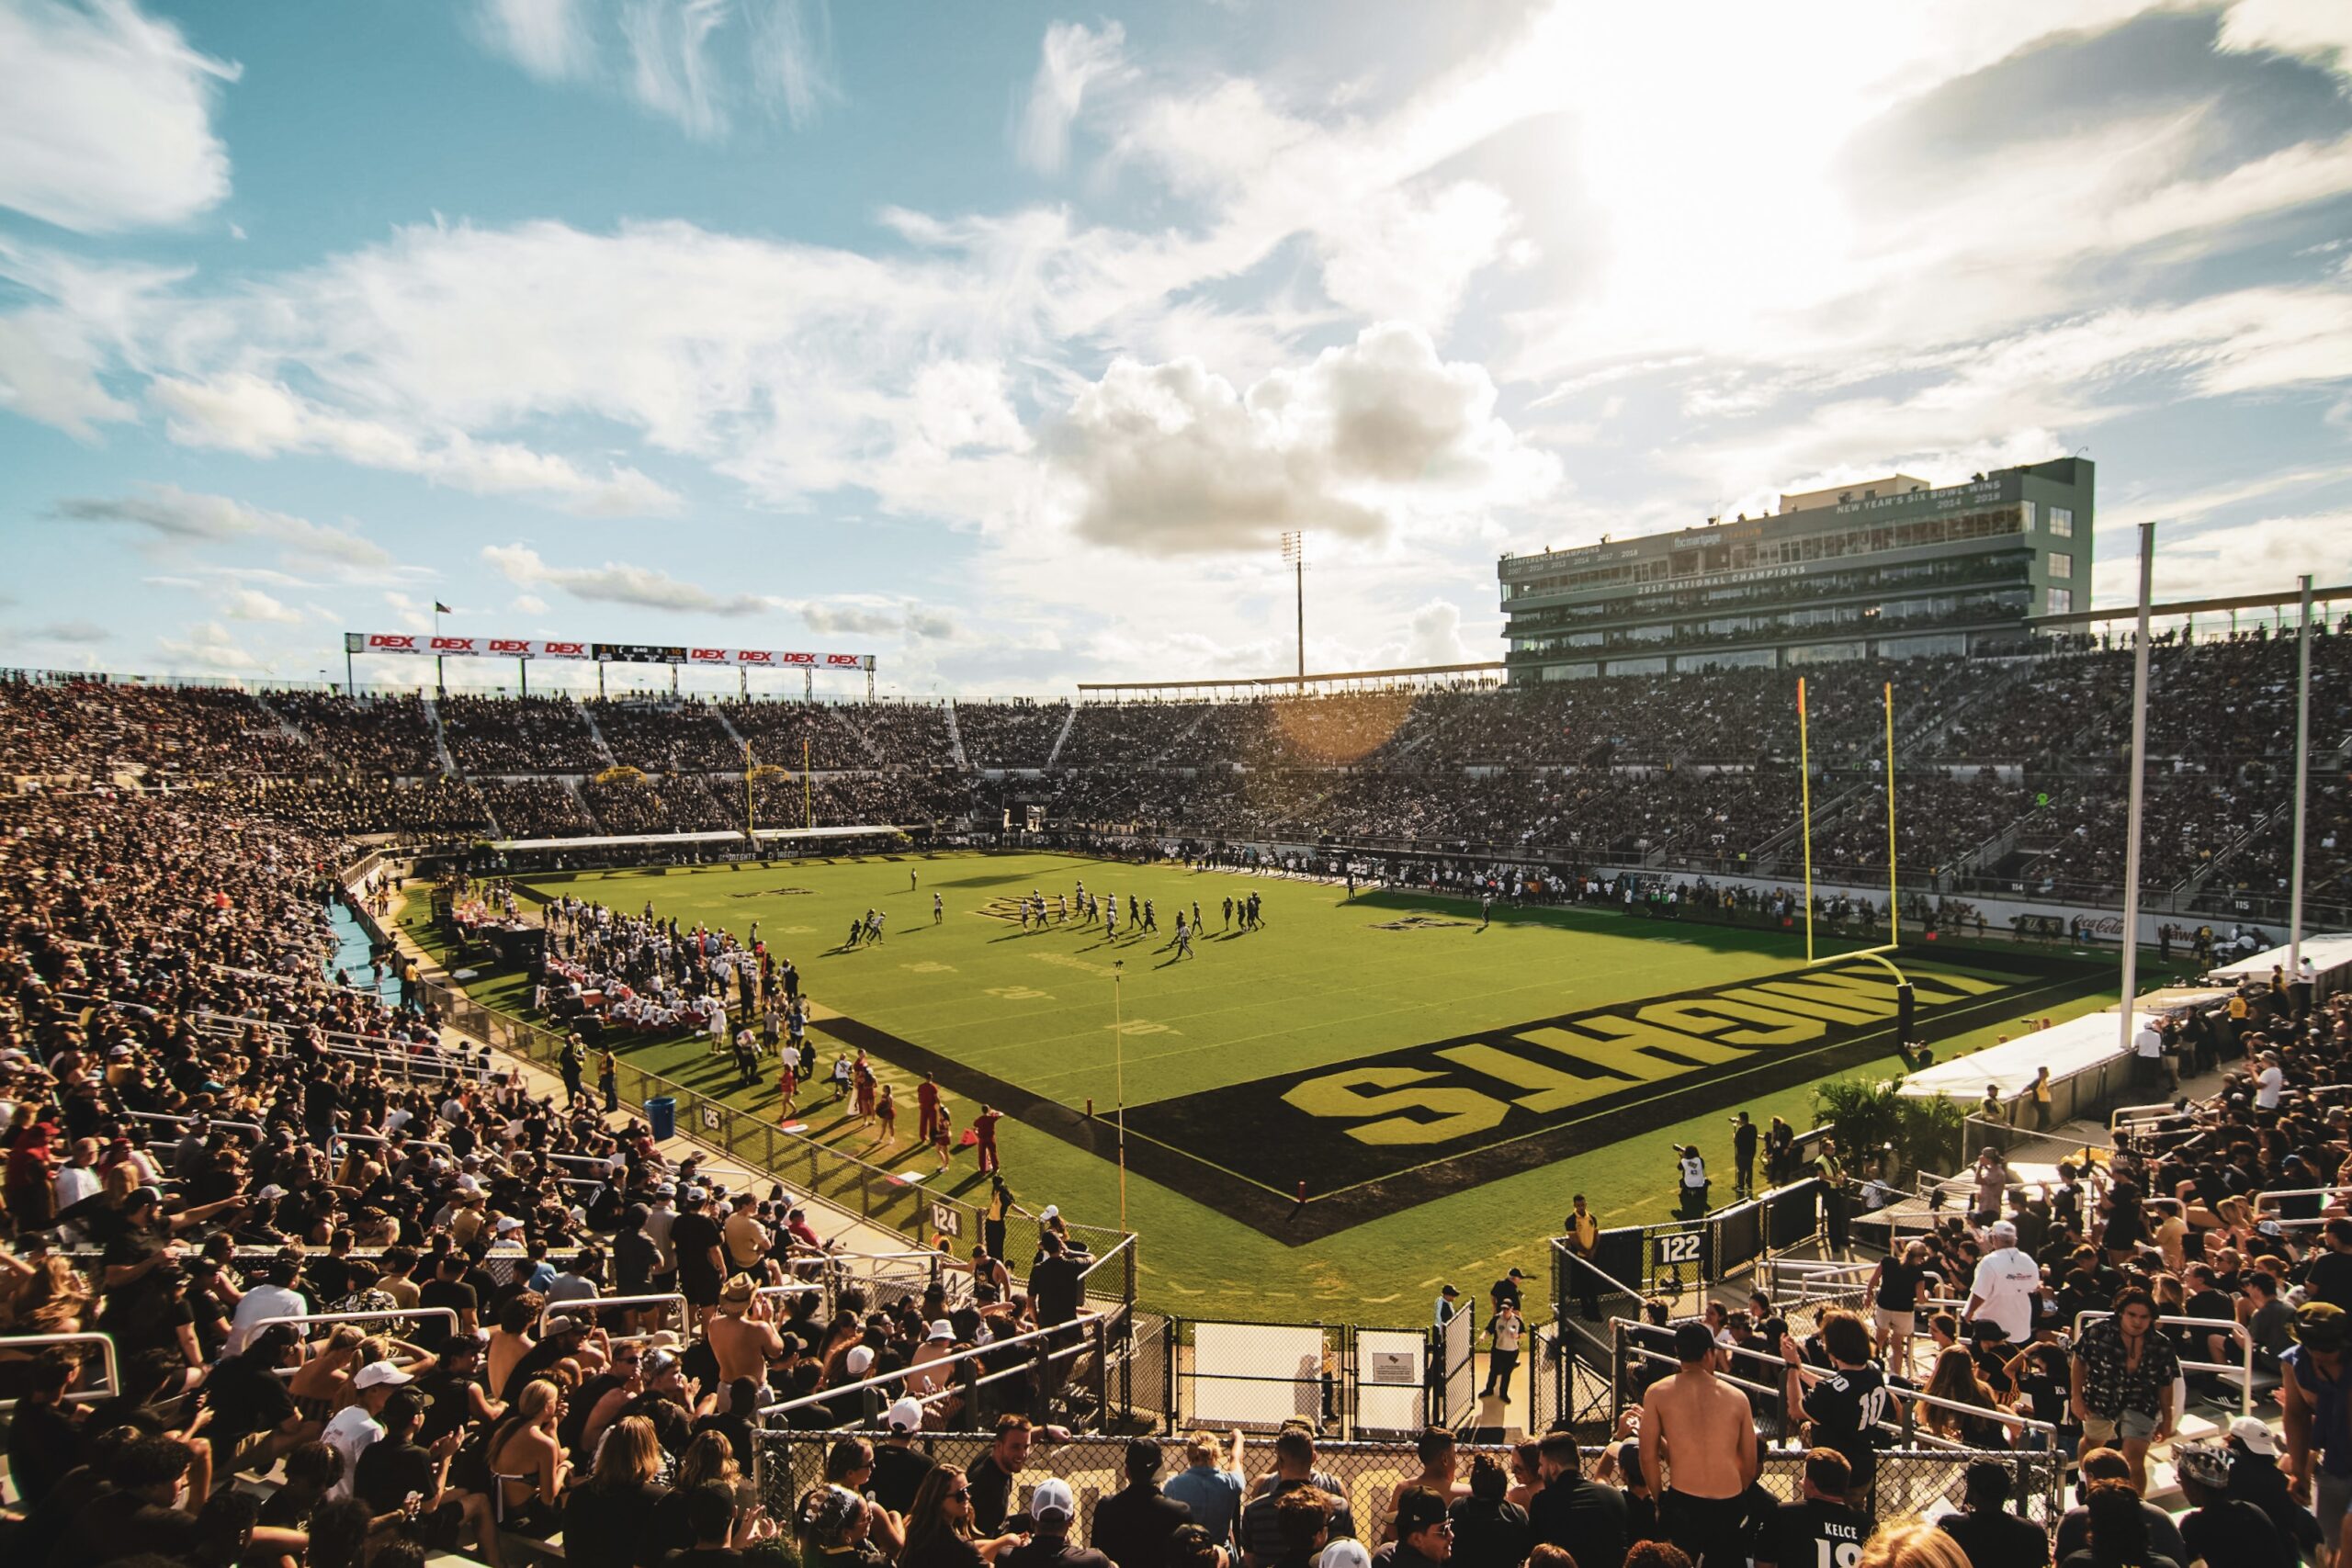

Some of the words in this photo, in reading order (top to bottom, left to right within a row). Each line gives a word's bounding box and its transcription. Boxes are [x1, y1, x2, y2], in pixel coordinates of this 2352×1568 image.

[1837, 505, 1860, 514] NEW
[1864, 497, 1904, 510] YEAR'S
[1907, 492, 1926, 502] SIX
[1930, 489, 1964, 499] BOWL
[1969, 480, 2001, 493] WINS
[1508, 555, 1554, 567] CONFERENCE
[1555, 546, 1600, 560] CHAMPIONS
[1638, 584, 1663, 594] 2017
[1669, 576, 1725, 591] NATIONAL
[1732, 566, 1805, 582] CHAMPIONS
[368, 635, 415, 648] DEX
[430, 637, 474, 649] DEX
[489, 640, 530, 651] DEX
[545, 642, 584, 654] DEX
[691, 649, 727, 660] DEX
[738, 650, 772, 661] DEX
[784, 653, 816, 662] DEX
[827, 655, 859, 665] DEX
[2234, 900, 2249, 909] 115
[704, 1108, 719, 1130] 125
[932, 1203, 958, 1235] 124
[1660, 1234, 1701, 1263] 122
[1858, 1386, 1886, 1431] 10
[1824, 1521, 1858, 1540] KELCE
